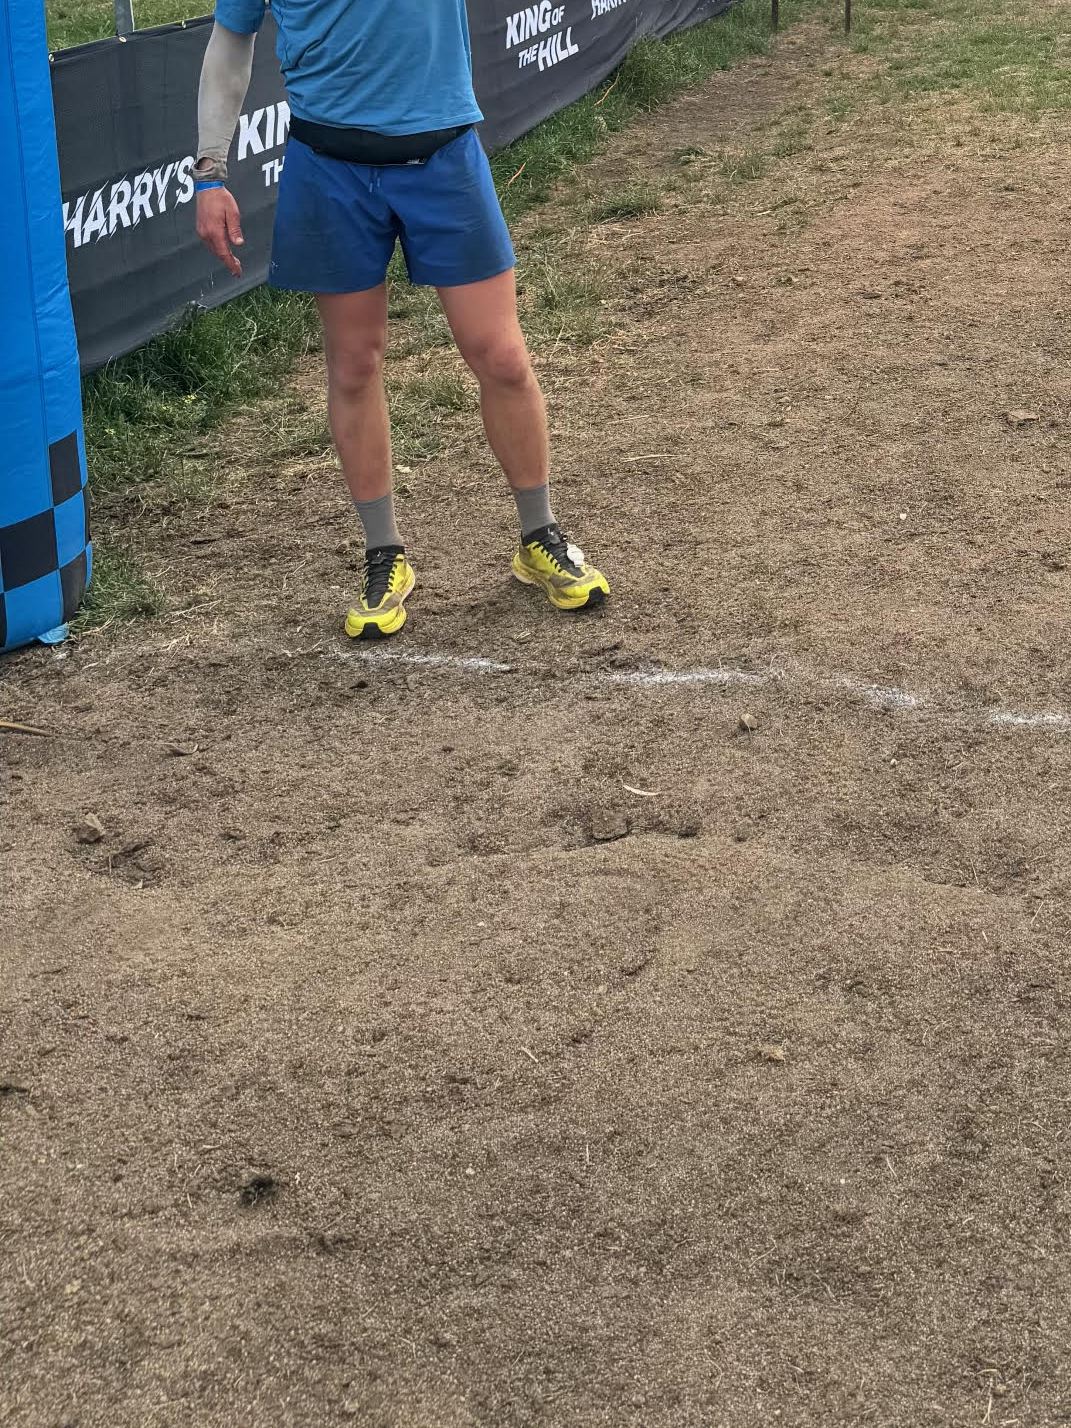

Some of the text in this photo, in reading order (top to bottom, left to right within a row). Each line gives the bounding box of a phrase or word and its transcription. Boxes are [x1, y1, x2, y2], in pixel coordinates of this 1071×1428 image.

[505, 0, 566, 49] KING OF
[518, 26, 579, 71] THE HILL
[237, 100, 291, 161] KIN
[262, 155, 285, 187] TH
[62, 155, 197, 249] HARRY'S
